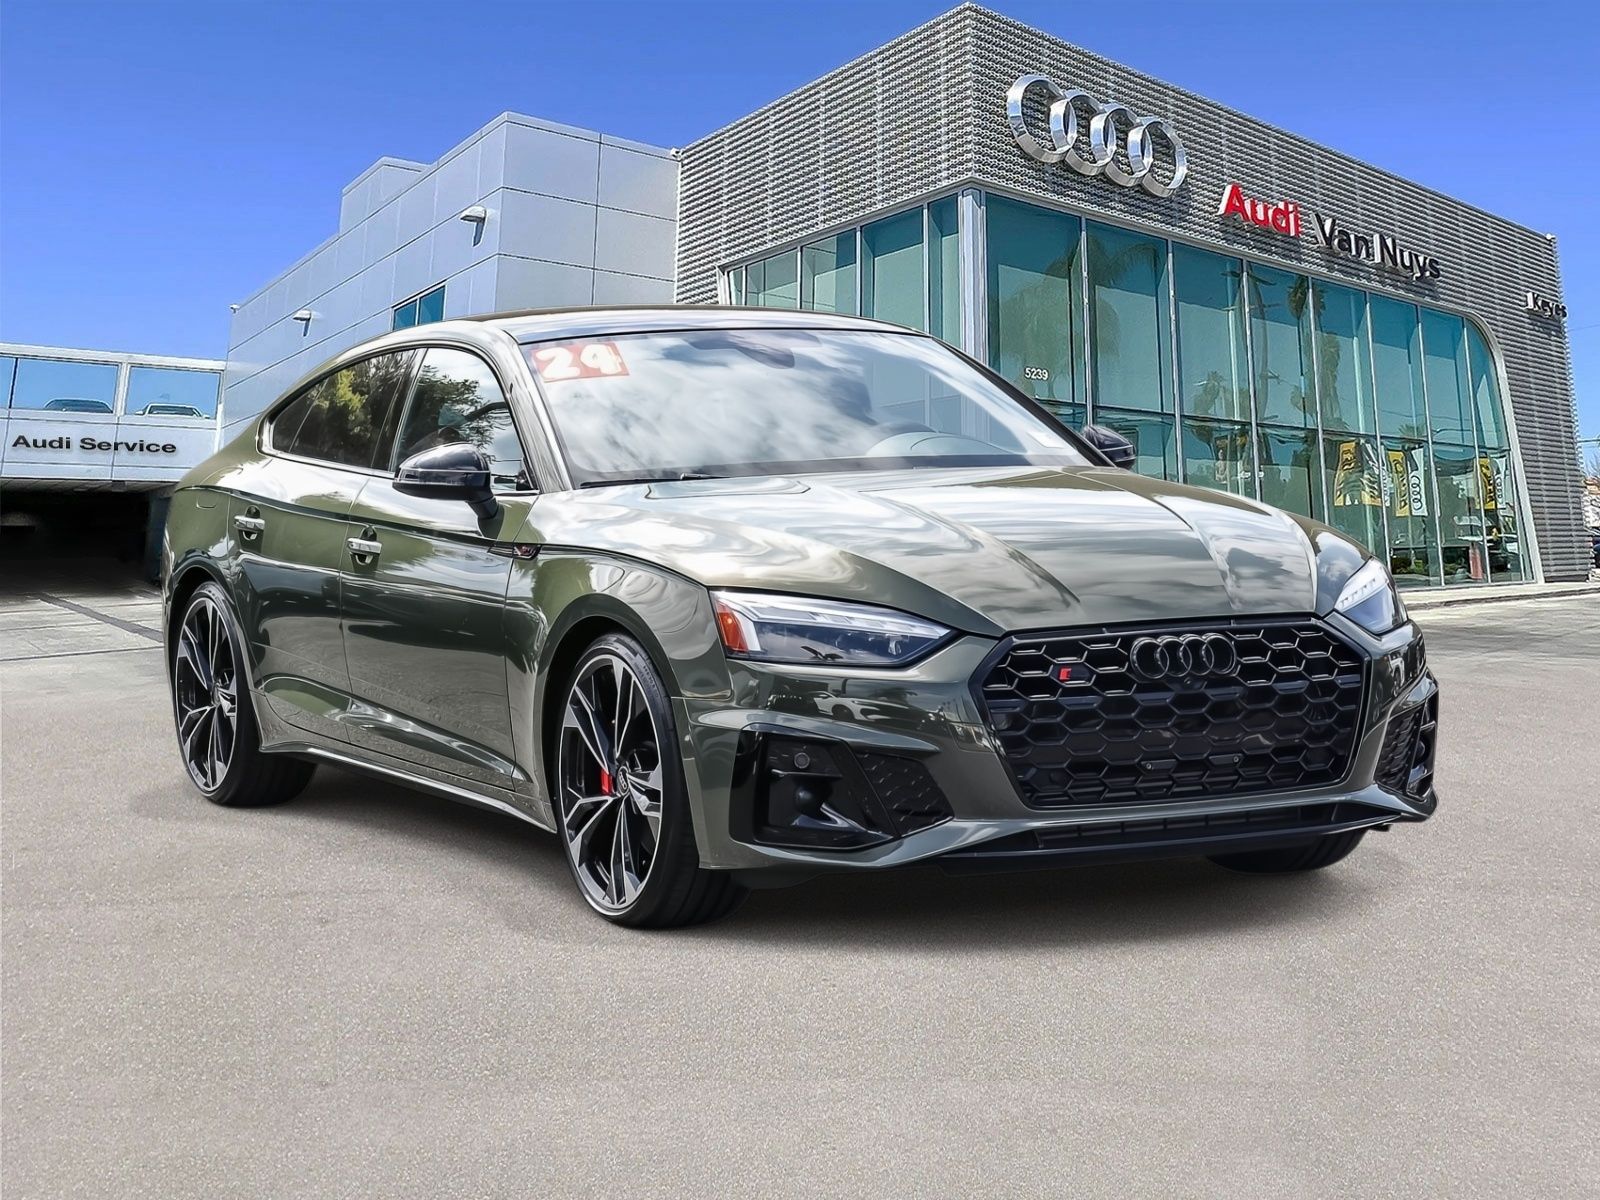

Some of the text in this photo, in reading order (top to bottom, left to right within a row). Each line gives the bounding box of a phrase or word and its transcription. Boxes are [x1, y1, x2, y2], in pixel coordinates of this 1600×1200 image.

[1216, 183, 1440, 281] Audi Van Nuys
[1024, 367, 1049, 380] 5239
[12, 435, 177, 453] Audi Service
